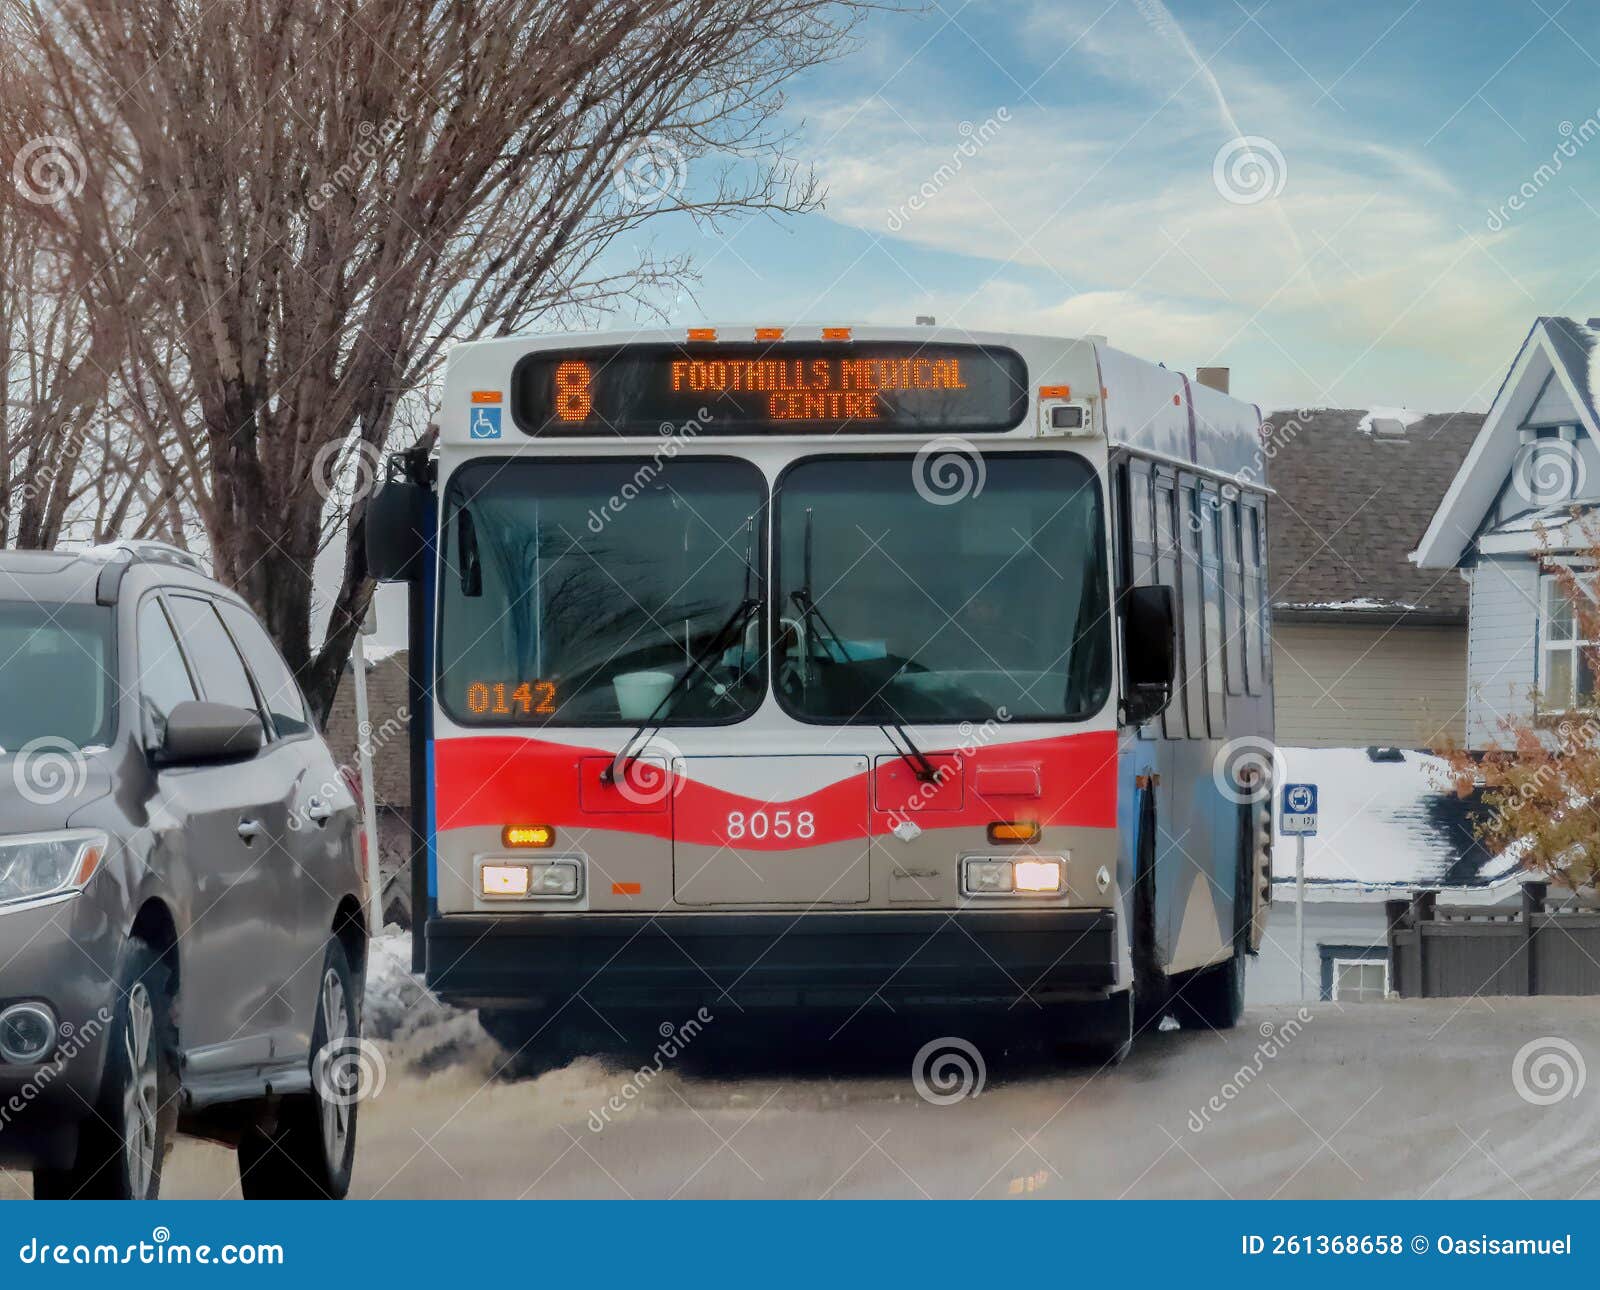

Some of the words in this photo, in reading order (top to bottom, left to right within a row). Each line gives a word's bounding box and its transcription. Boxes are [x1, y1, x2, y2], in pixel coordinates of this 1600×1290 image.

[672, 360, 829, 391] FOOTHILLS
[841, 359, 967, 389] MEDICAL
[556, 362, 591, 421] 8
[768, 391, 880, 420] CENTRE
[467, 682, 556, 713] 0142
[726, 811, 817, 839] 8058
